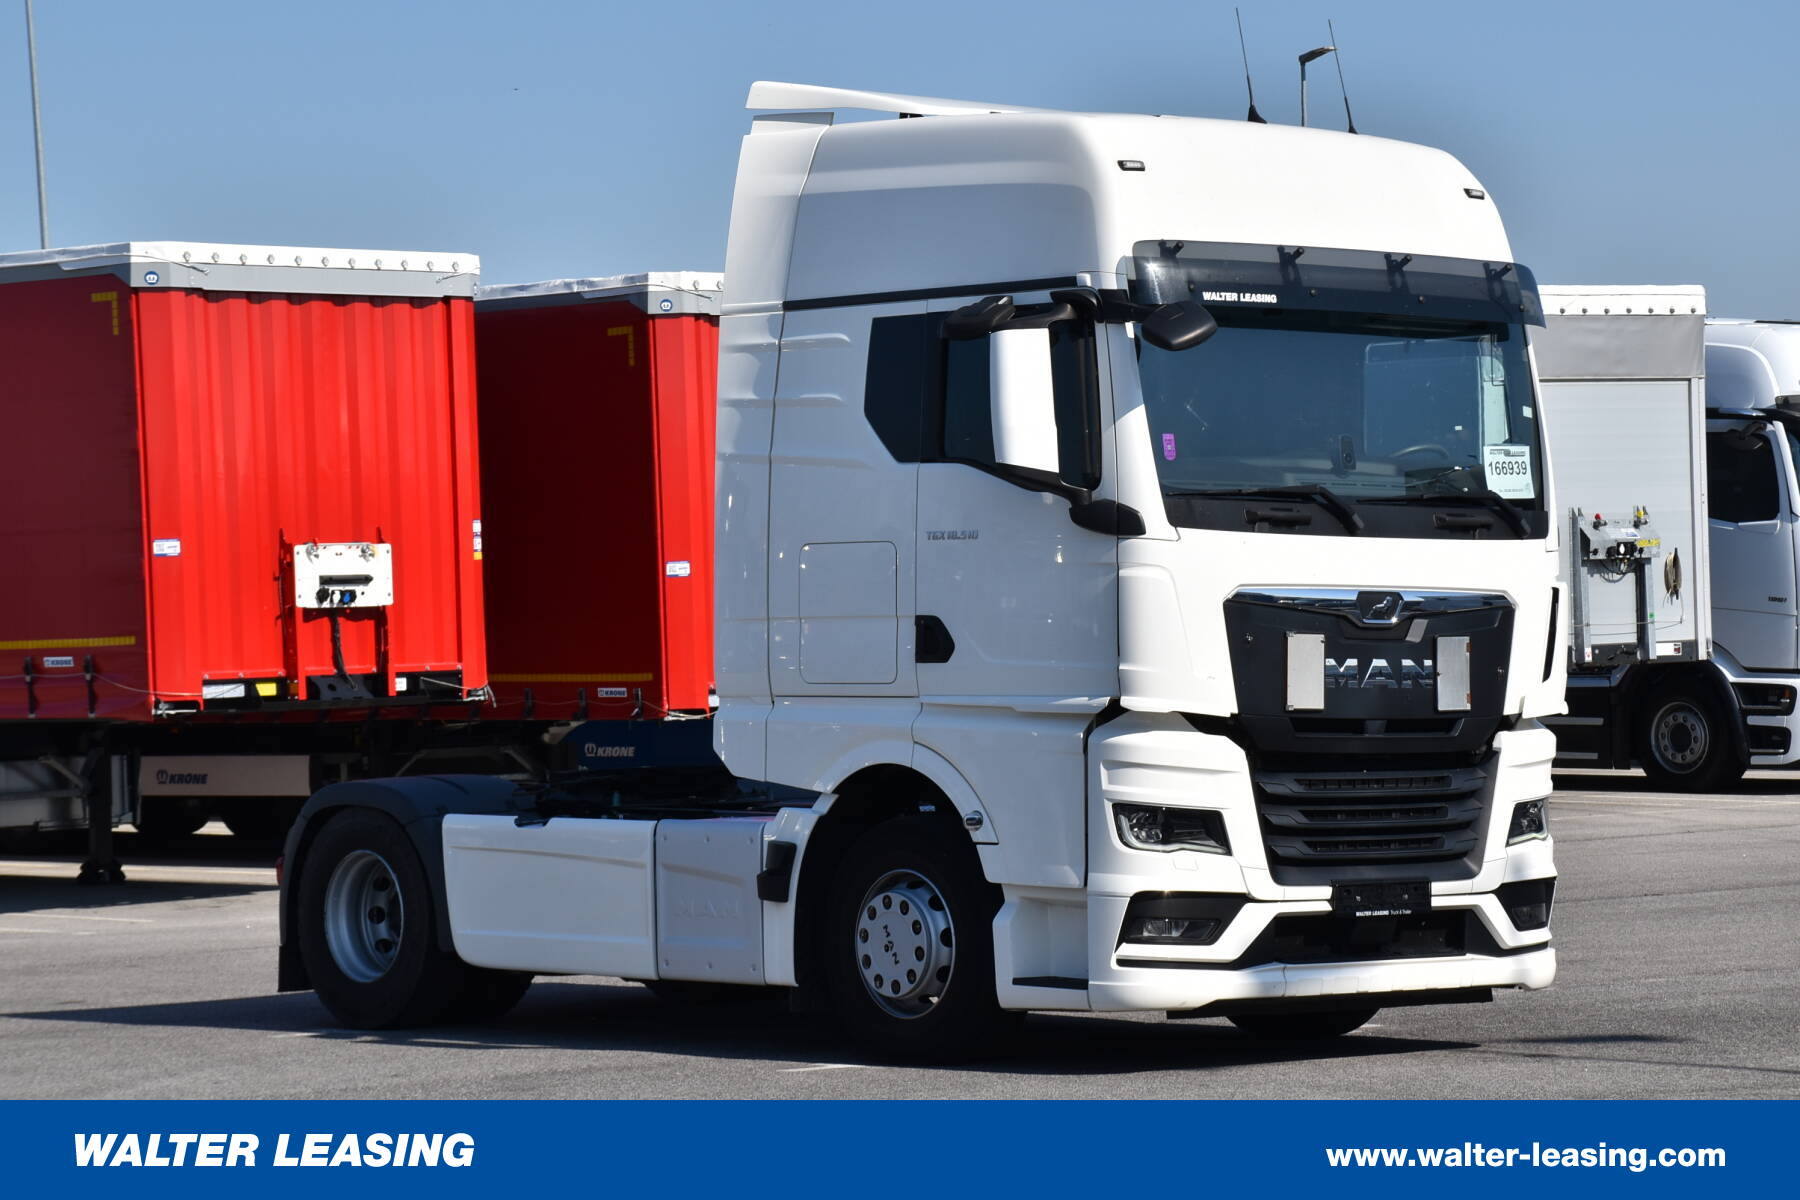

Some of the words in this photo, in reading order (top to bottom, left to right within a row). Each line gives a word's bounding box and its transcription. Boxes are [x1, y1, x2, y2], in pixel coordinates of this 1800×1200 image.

[1202, 291, 1239, 302] WALTER
[1240, 292, 1278, 304] LEASING
[1488, 460, 1528, 476] 166939
[1325, 658, 1433, 689] MAN
[604, 689, 627, 697] KRONE
[597, 746, 636, 758] KRONE
[168, 773, 209, 785] KRONE
